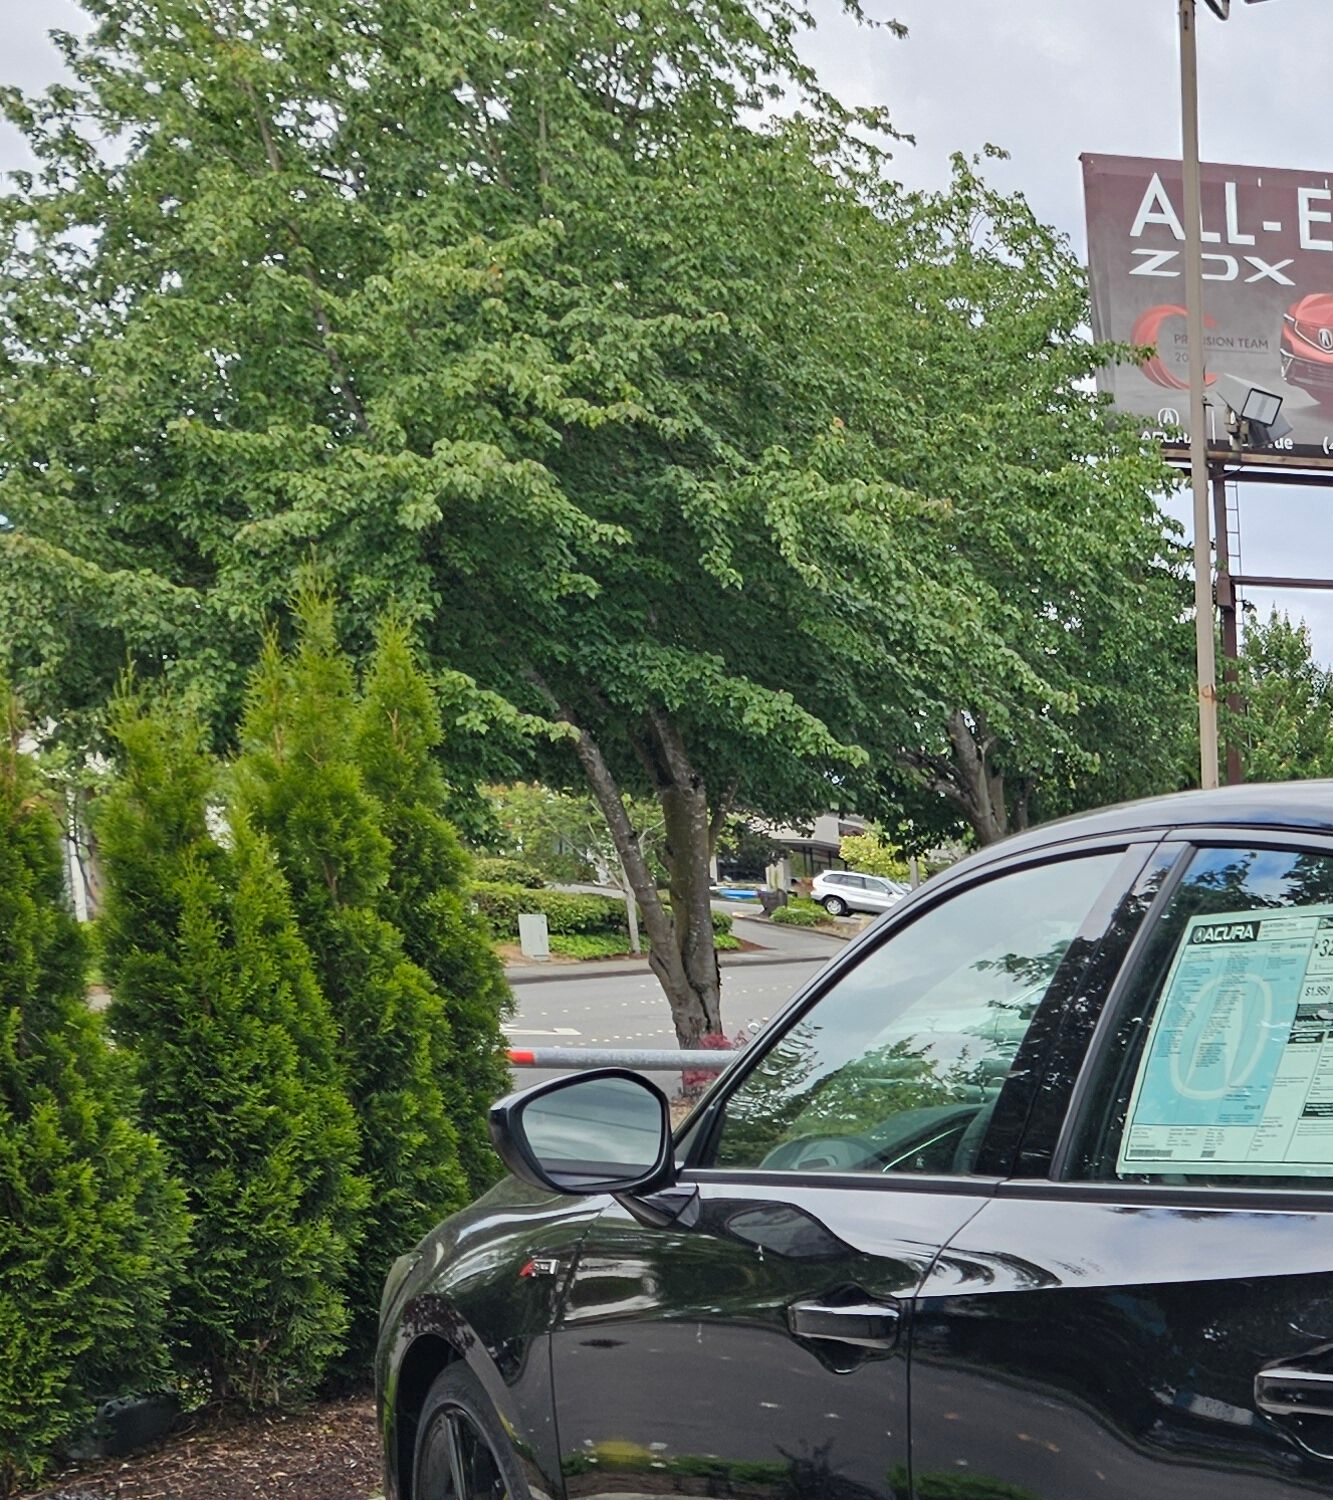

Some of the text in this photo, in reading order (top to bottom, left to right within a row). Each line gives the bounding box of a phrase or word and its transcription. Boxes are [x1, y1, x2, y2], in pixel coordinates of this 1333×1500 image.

[1129, 248, 1295, 286] ZDX
[1174, 334, 1269, 349] PRISION TEAM
[1141, 430, 1193, 444] ACUR
[1203, 924, 1254, 942] ACURA
